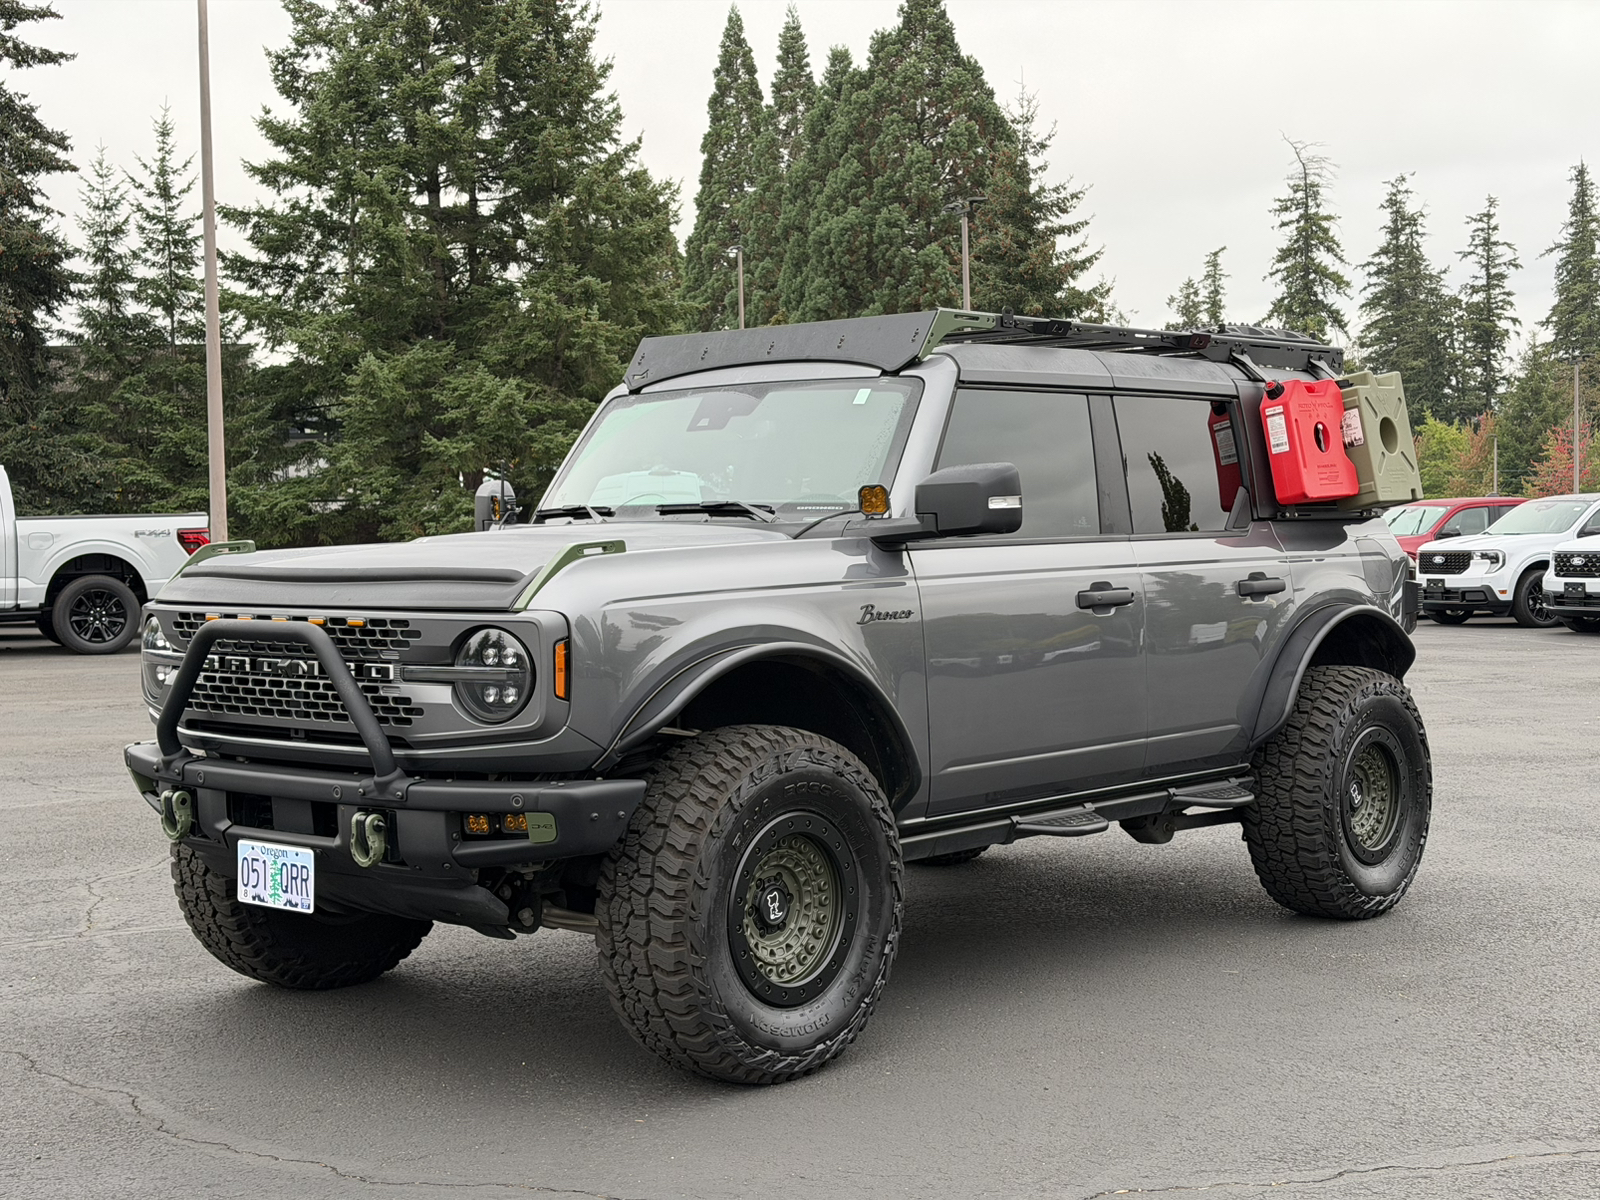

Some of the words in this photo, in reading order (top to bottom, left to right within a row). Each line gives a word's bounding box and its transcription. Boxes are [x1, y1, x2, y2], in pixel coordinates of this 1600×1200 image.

[856, 603, 915, 625] Bronco
[784, 781, 832, 799] BOSS
[260, 845, 289, 860] Oregon
[241, 856, 267, 891] 051
[280, 862, 310, 898] QRR
[841, 933, 879, 1009] MICKEY
[749, 1013, 834, 1038] THOMPSON
